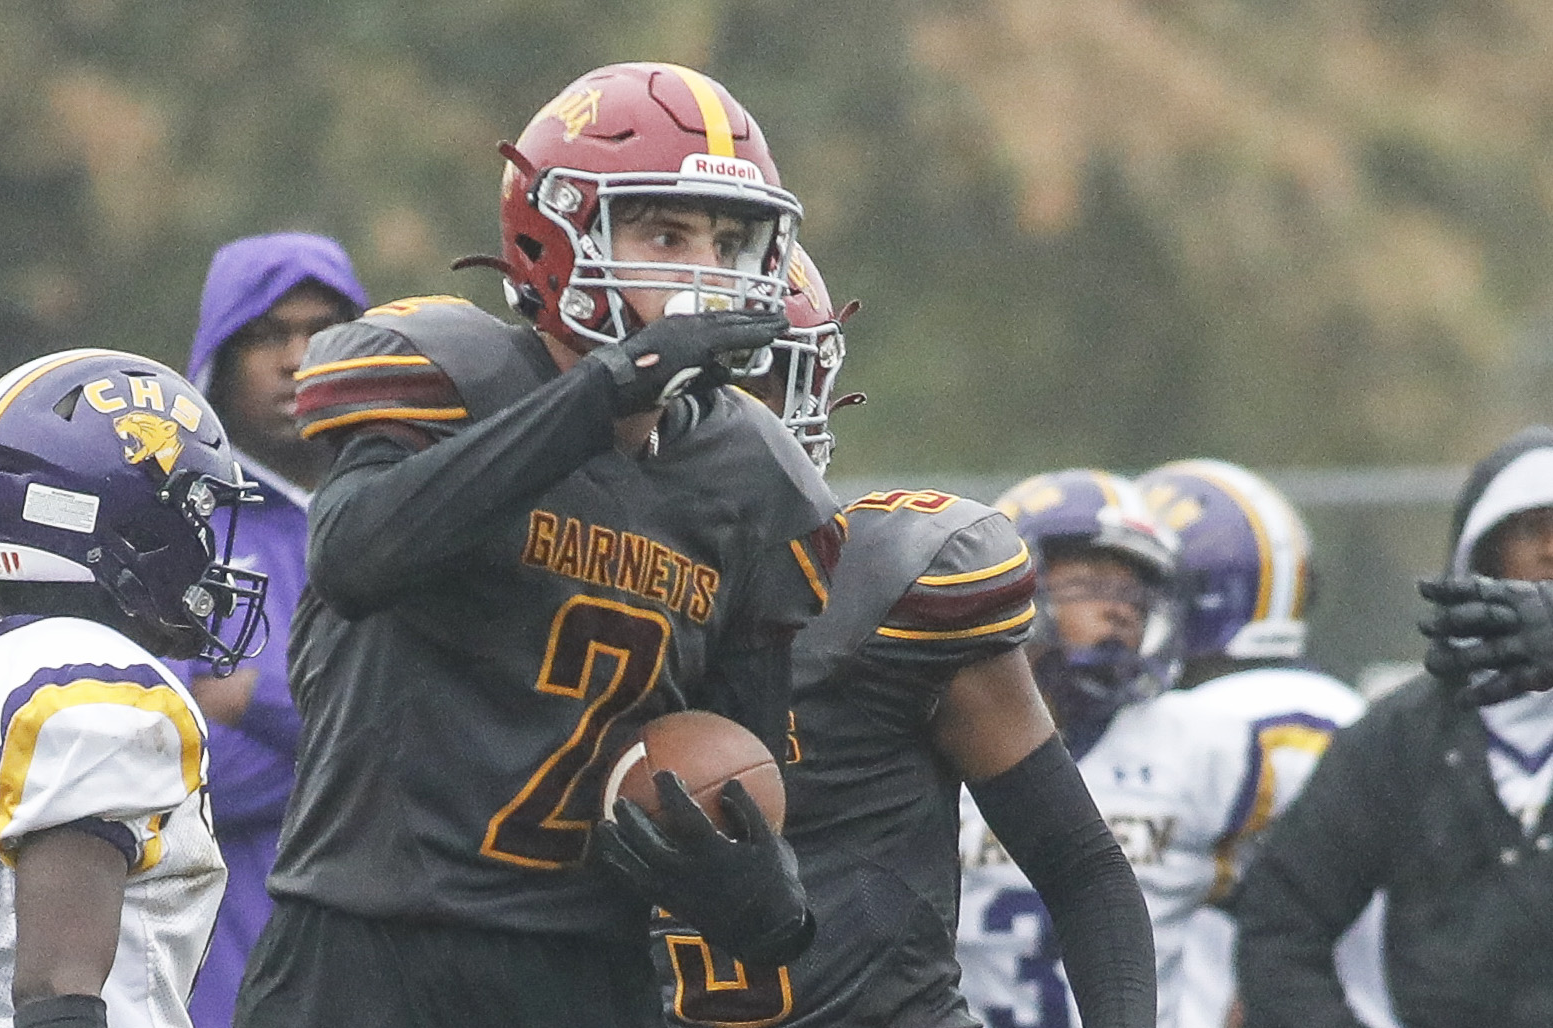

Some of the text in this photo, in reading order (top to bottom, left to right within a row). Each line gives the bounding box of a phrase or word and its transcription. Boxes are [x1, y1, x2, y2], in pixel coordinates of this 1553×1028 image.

[696, 160, 756, 180] Riddell
[83, 377, 203, 433] CHS
[521, 509, 721, 625] GARNETS
[480, 594, 672, 869] 2
